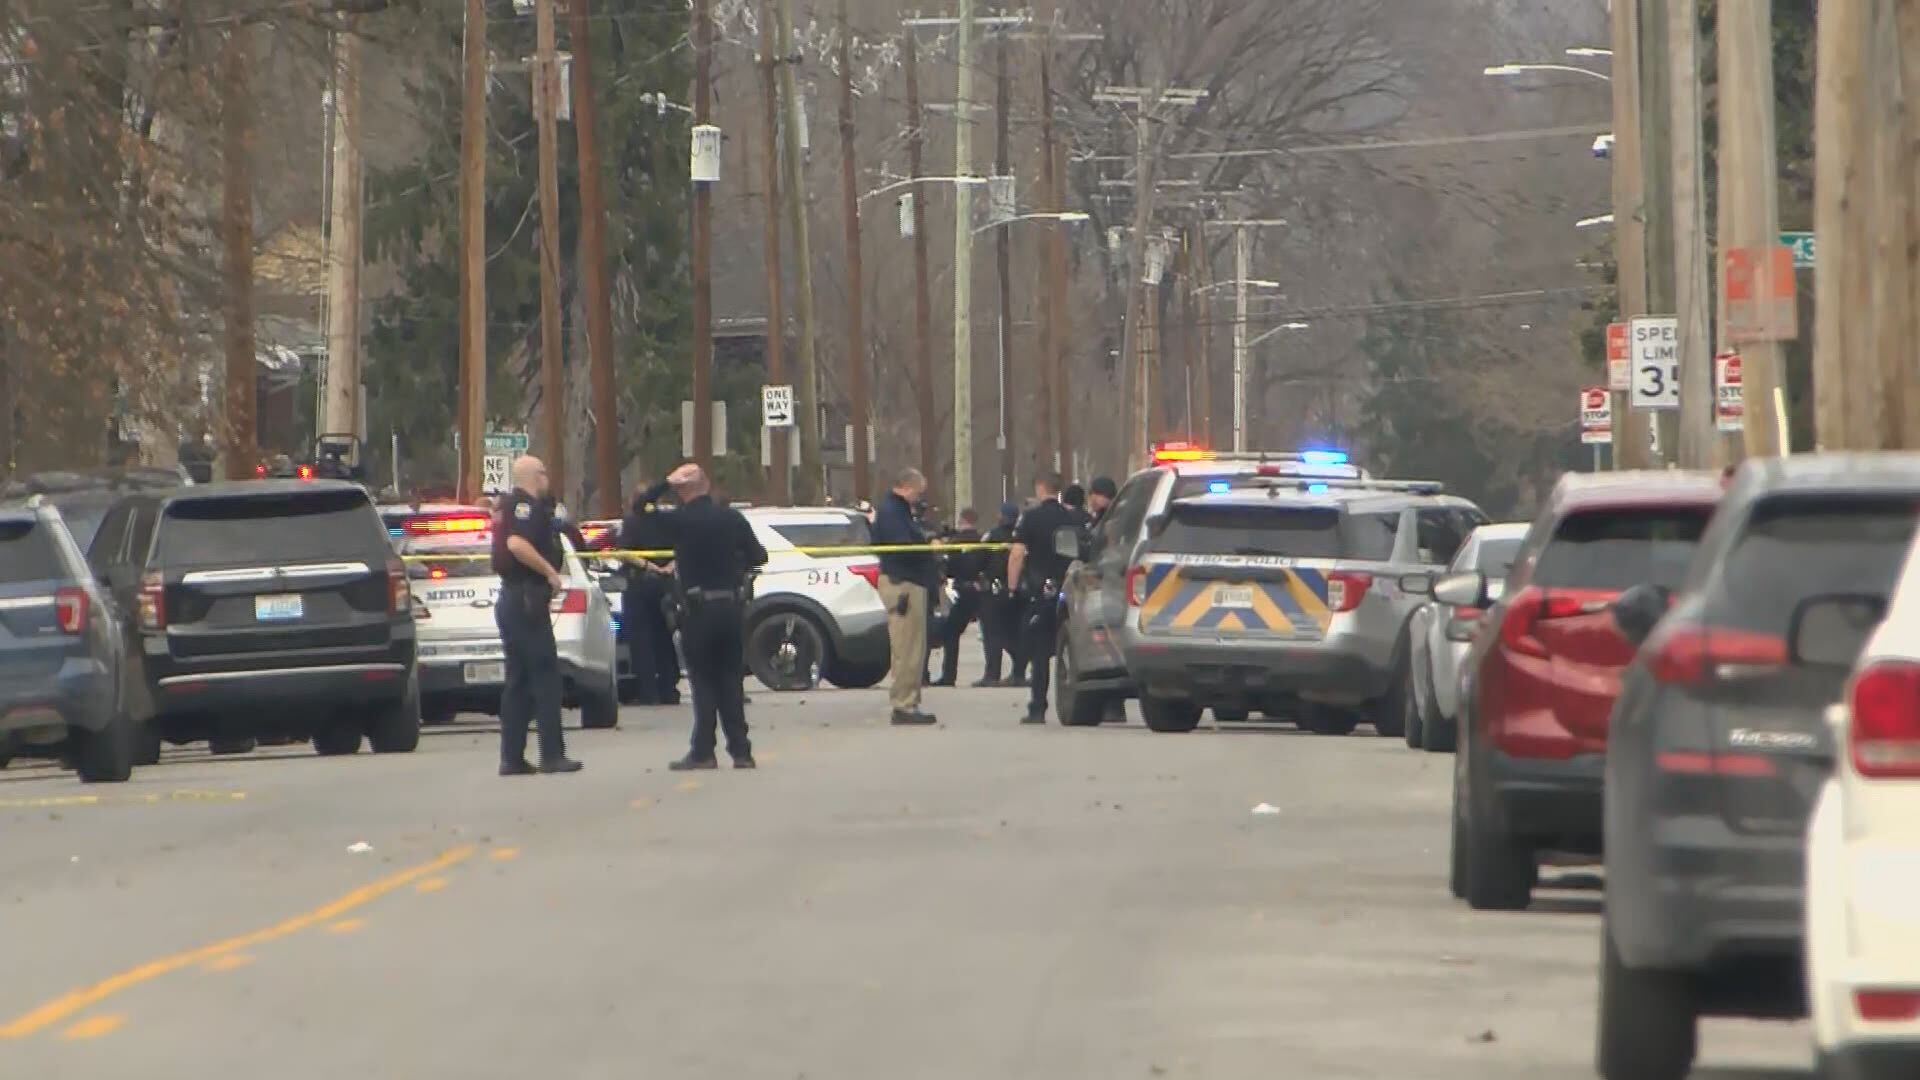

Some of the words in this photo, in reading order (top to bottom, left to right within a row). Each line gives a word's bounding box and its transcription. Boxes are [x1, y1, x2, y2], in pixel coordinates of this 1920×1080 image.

[1636, 327, 1678, 341] SPE
[1643, 346, 1678, 360] LIM
[766, 390, 789, 400] ONE
[1719, 387, 1744, 398] STO
[766, 401, 789, 410] WAY
[486, 459, 505, 471] NE
[486, 472, 505, 484] AY
[426, 589, 476, 601] METRO
